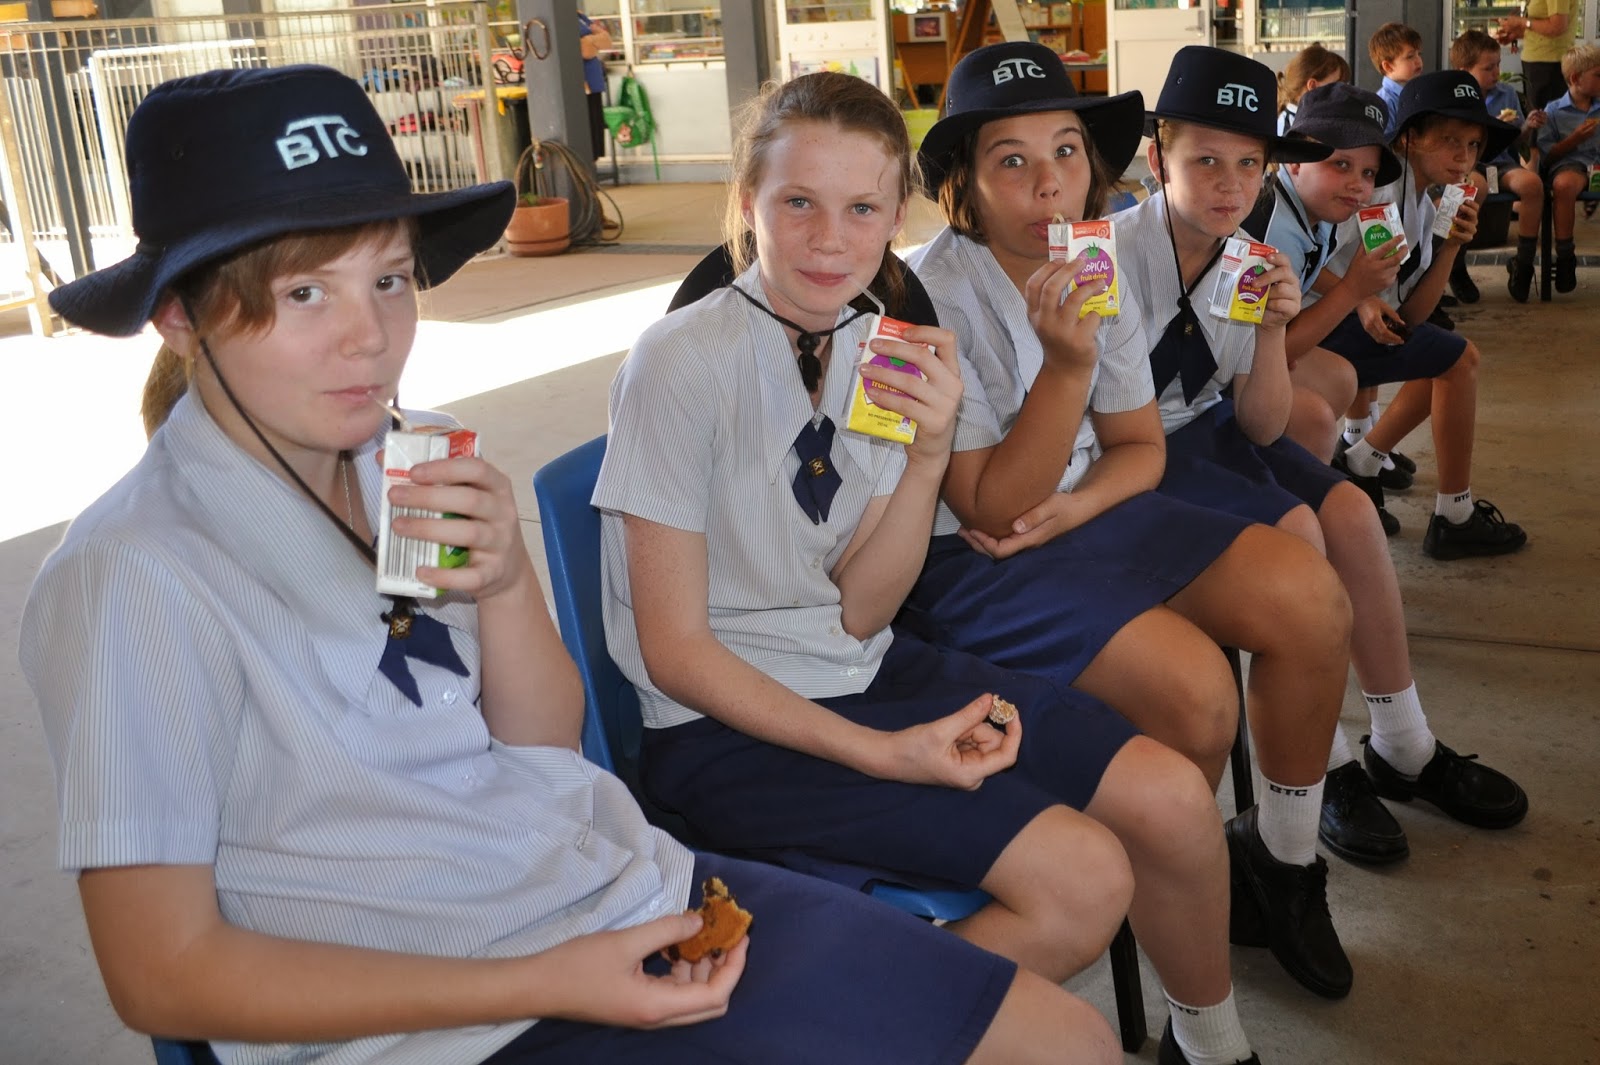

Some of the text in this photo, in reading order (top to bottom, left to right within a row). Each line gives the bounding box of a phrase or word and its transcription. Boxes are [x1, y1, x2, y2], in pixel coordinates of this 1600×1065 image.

[993, 58, 1047, 86] BTC
[1216, 83, 1259, 112] BTC
[1453, 84, 1480, 100] BTC
[275, 115, 368, 171] BTC
[1080, 273, 1093, 282] fruit
[1269, 783, 1308, 797] BTC
